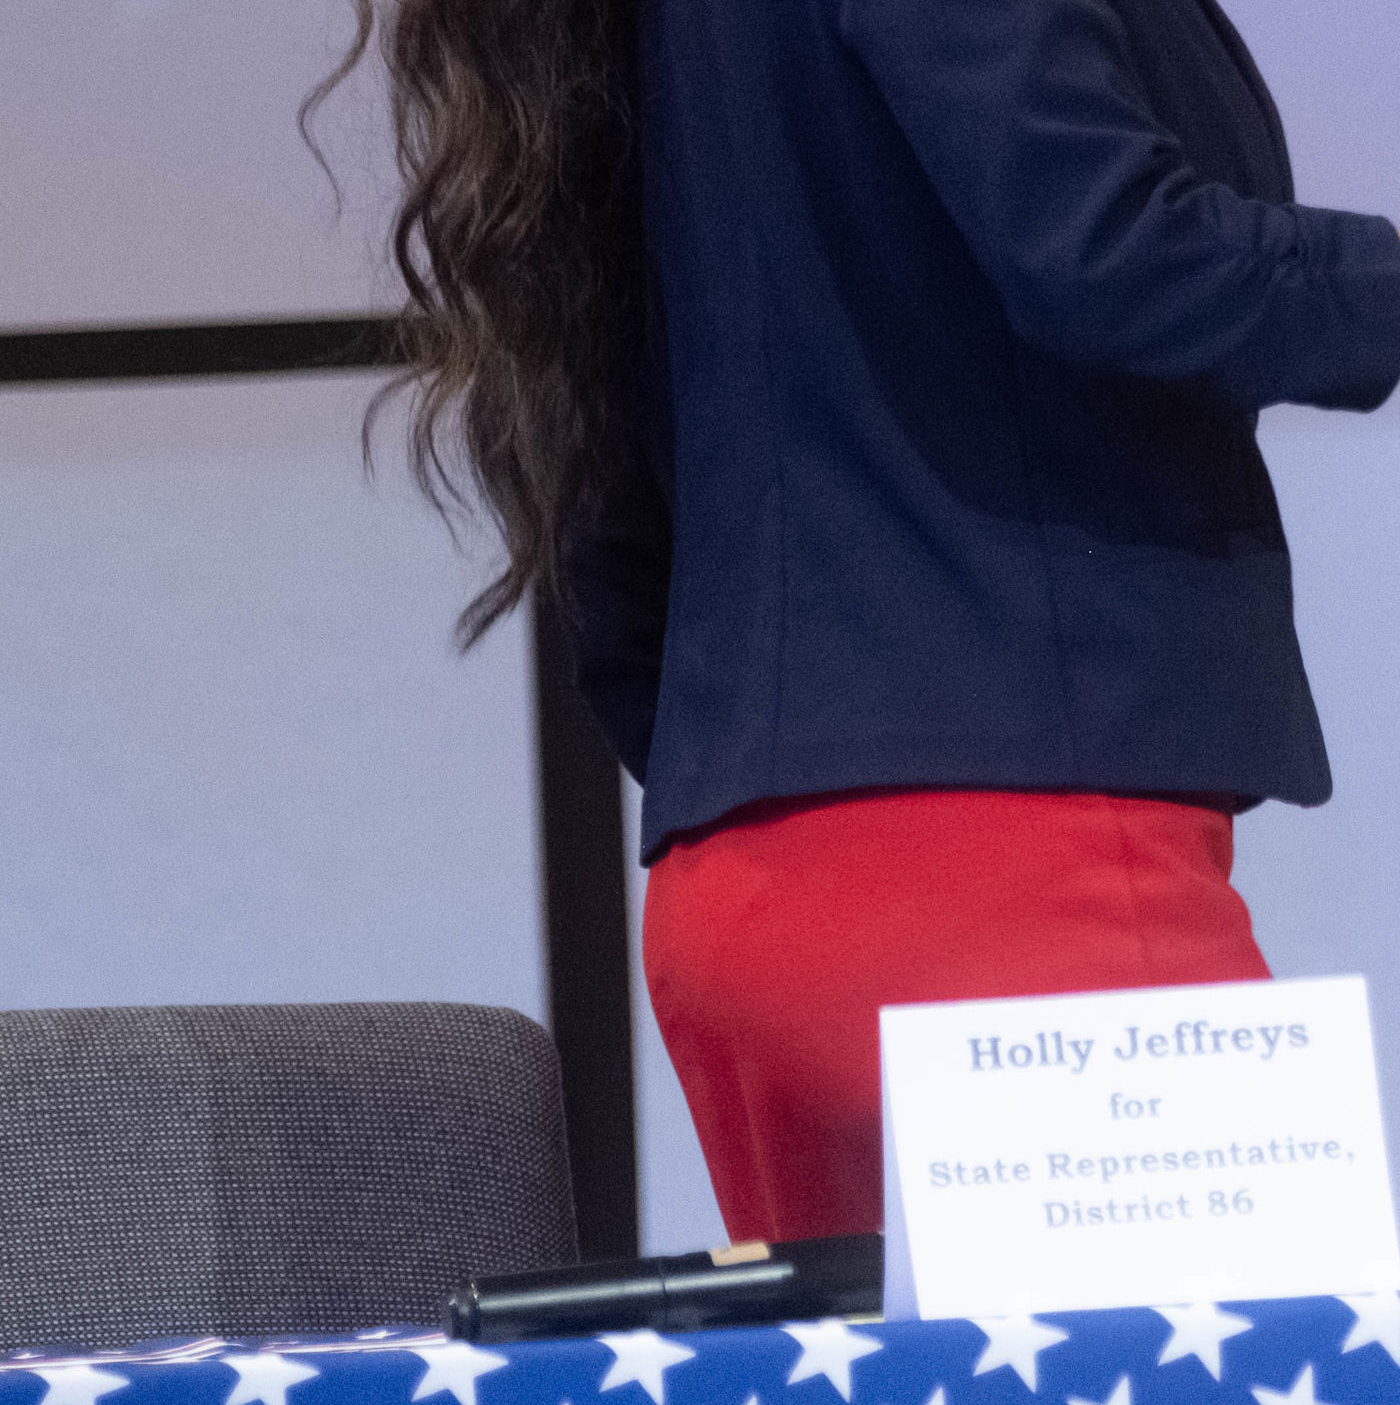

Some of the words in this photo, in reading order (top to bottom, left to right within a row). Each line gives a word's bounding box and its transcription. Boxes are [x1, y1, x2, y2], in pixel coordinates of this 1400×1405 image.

[966, 1029, 1095, 1074] Holly
[1113, 1019, 1310, 1062] Jeffreys
[1108, 1091, 1163, 1121] for
[928, 1158, 1031, 1188] State
[1045, 1134, 1355, 1182] Representative,
[1042, 1193, 1192, 1229] District
[1207, 1187, 1255, 1217] 86
